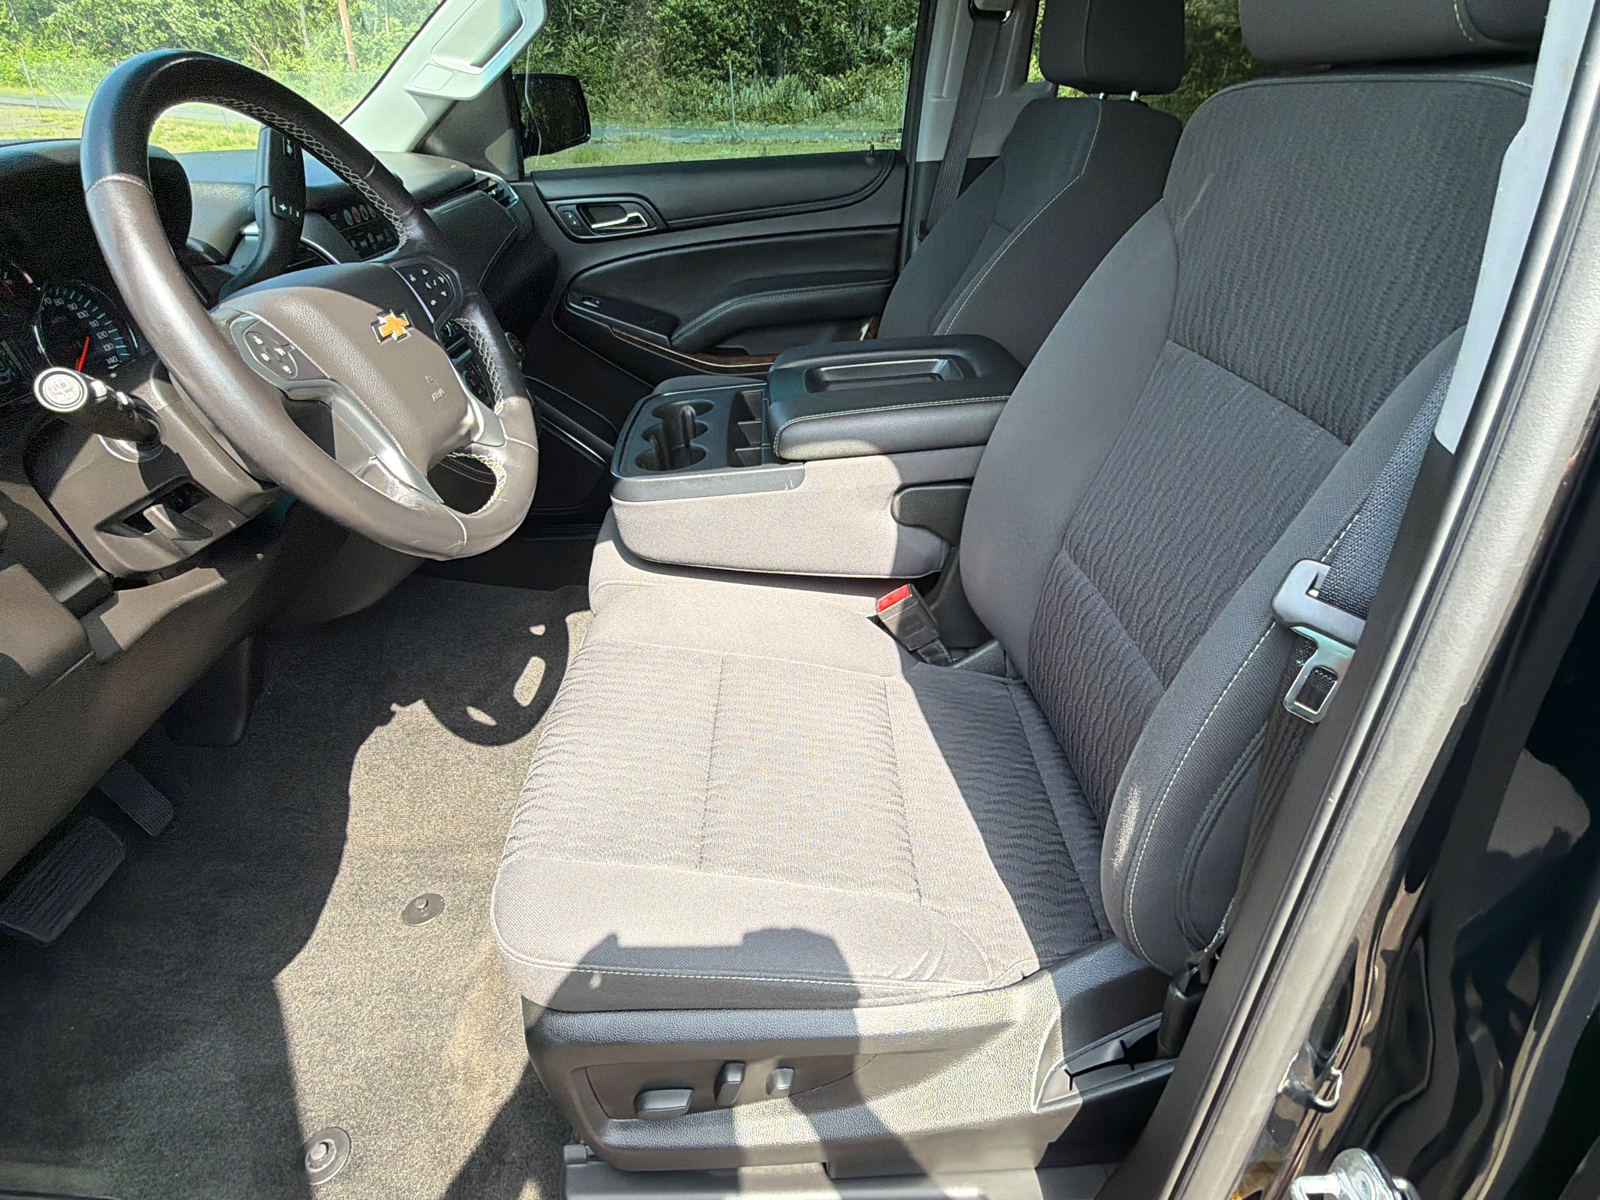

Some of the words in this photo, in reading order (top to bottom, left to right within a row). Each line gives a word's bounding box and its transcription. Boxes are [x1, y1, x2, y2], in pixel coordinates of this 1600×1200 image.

[54, 298, 64, 306] 80
[67, 303, 78, 311] 90
[77, 310, 89, 319] 100
[89, 320, 99, 328] 110
[97, 331, 108, 339] 120
[103, 343, 114, 351] 130
[107, 356, 118, 364] 140
